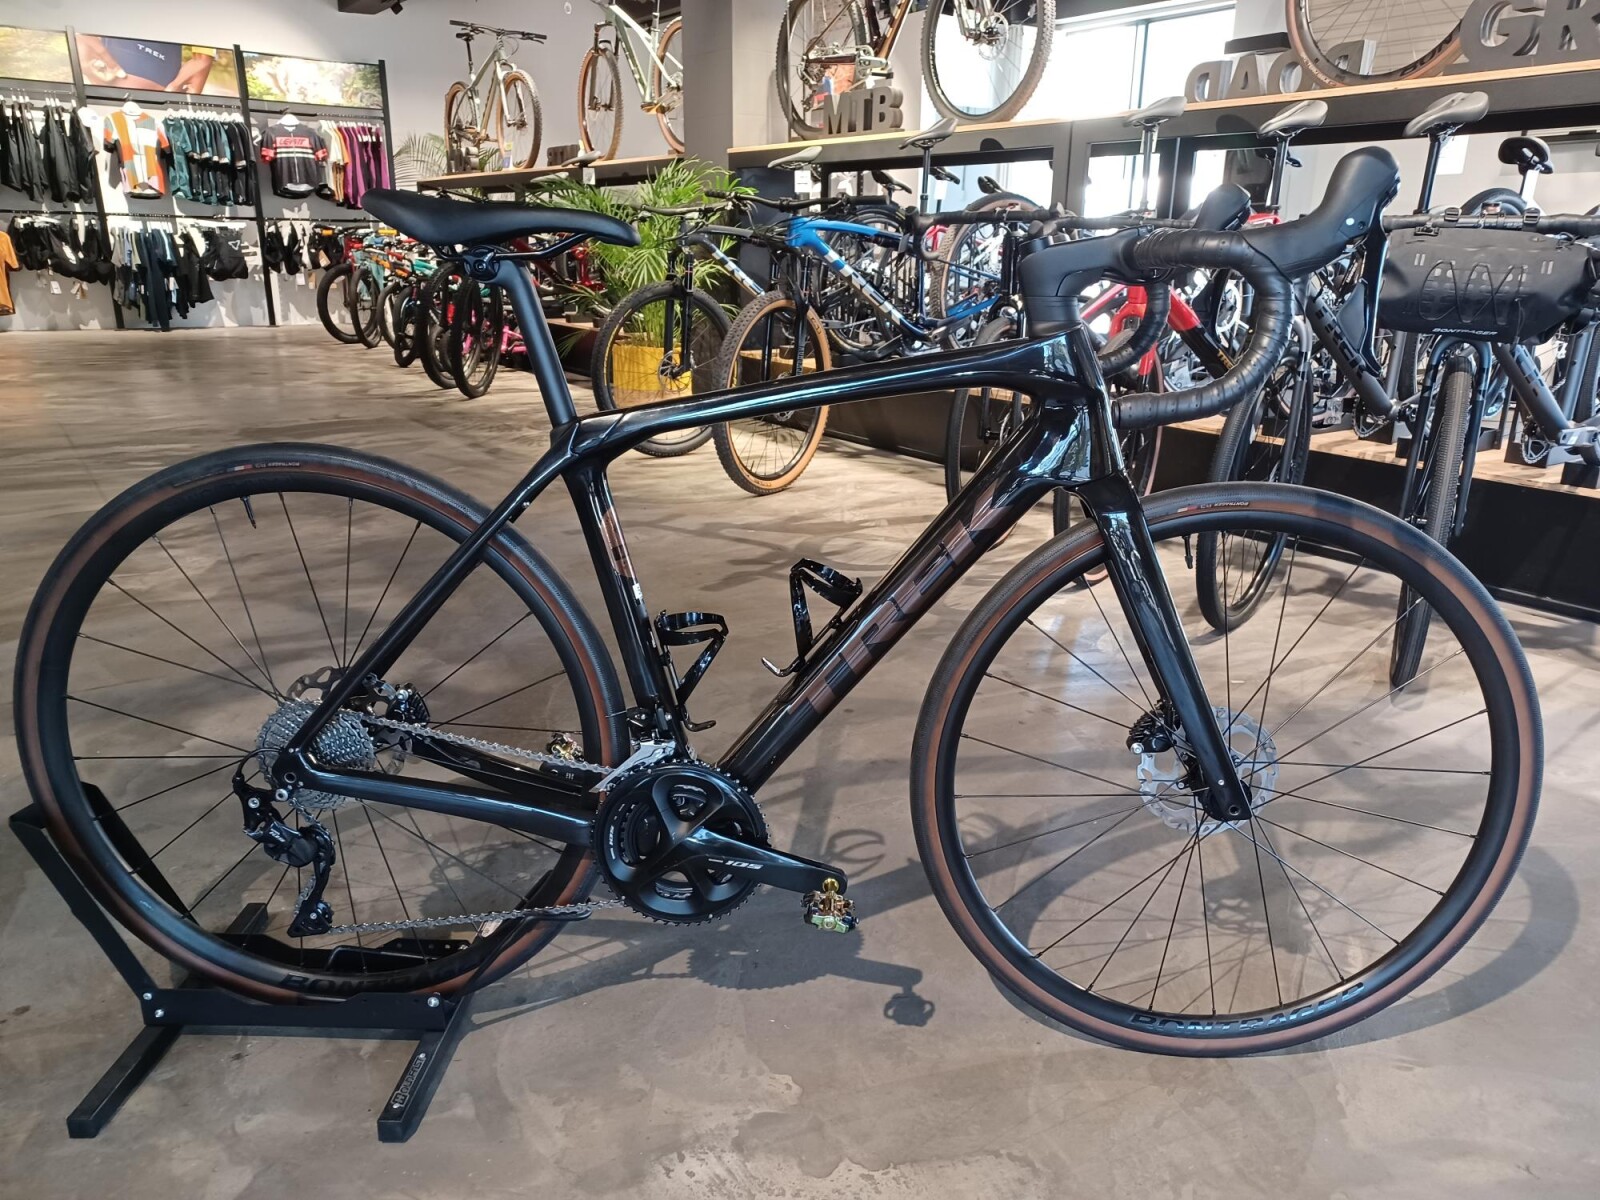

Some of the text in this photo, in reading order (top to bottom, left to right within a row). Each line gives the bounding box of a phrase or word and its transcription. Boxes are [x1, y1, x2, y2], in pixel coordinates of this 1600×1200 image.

[137, 43, 166, 61] TREK
[822, 86, 904, 136] MTB
[822, 248, 902, 326] TREK
[1431, 327, 1499, 336] BONTRAGER
[787, 478, 1013, 716] TREK
[726, 860, 763, 869] 105
